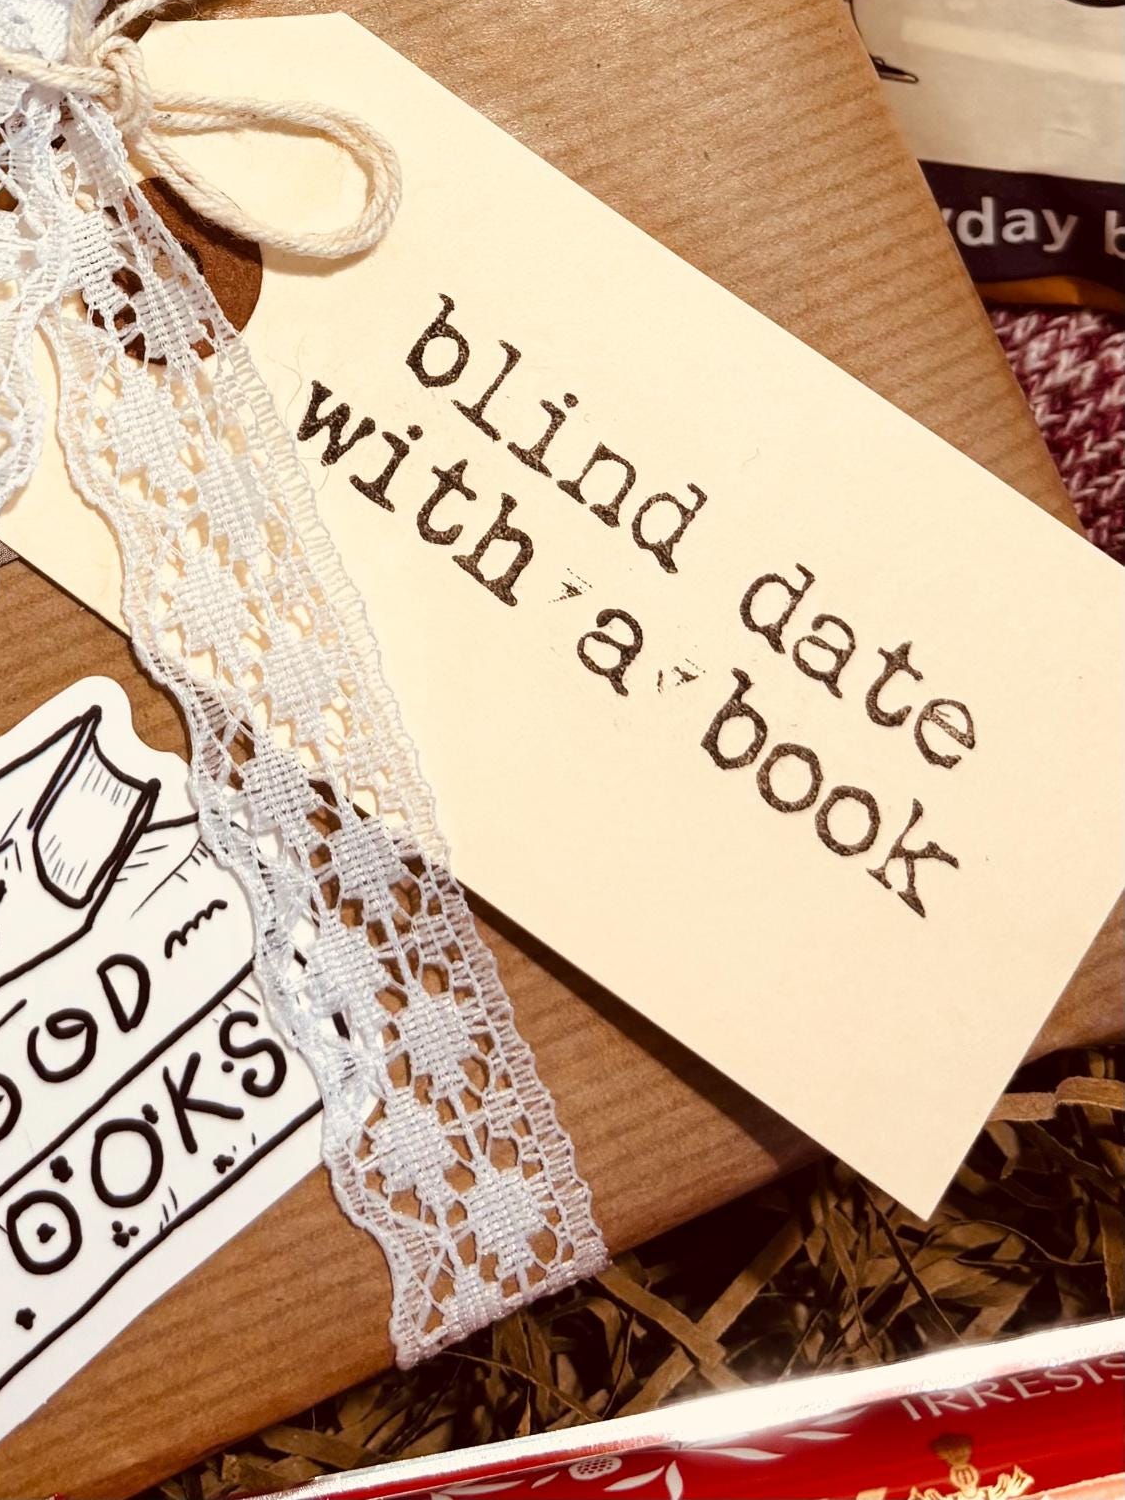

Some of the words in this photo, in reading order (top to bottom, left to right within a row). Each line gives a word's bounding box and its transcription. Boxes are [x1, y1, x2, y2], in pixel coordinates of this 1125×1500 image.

[297, 380, 534, 607] with
[577, 609, 643, 697] a
[701, 668, 959, 919] book
[406, 293, 707, 574] blind
[739, 563, 976, 769] date
